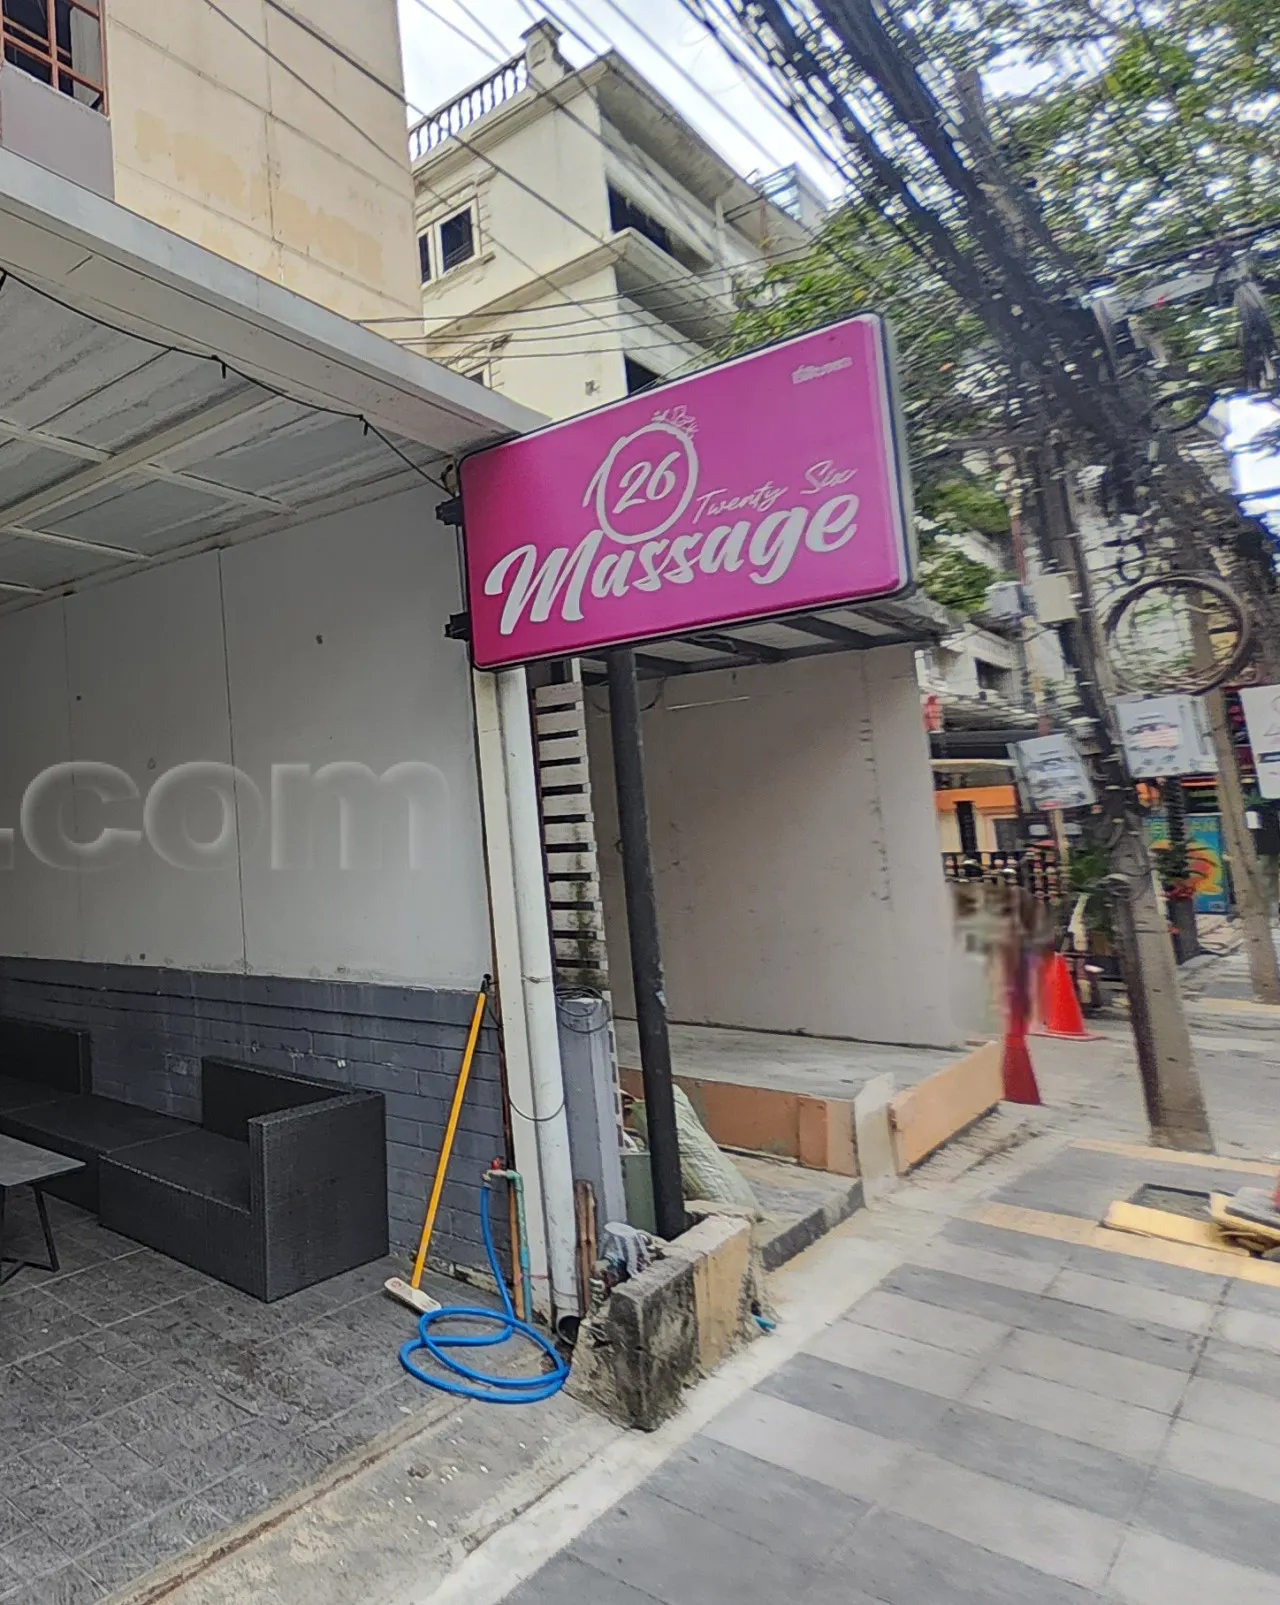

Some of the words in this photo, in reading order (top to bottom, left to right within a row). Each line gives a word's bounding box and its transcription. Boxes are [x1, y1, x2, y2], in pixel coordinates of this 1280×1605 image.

[613, 451, 681, 514] 26
[692, 480, 788, 525] Twenty
[800, 460, 858, 495] Six
[484, 494, 860, 635] Massage
